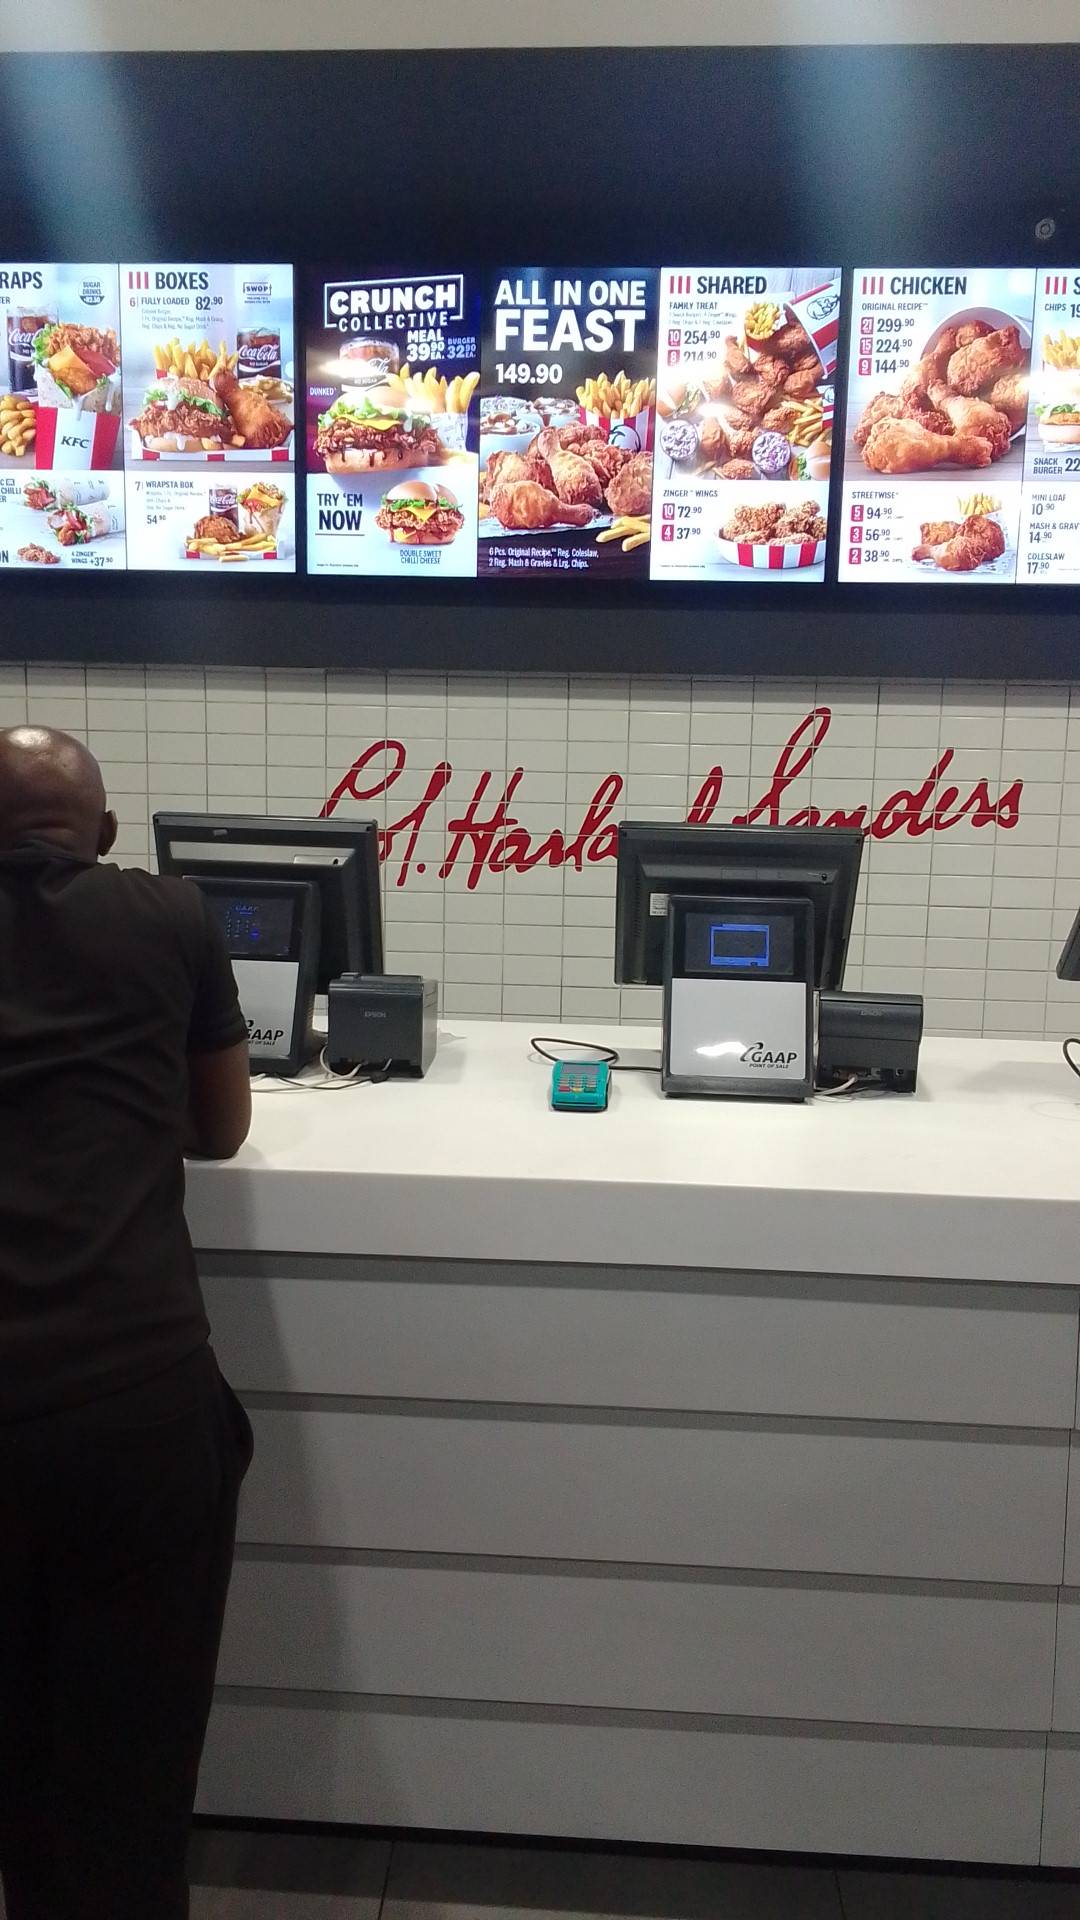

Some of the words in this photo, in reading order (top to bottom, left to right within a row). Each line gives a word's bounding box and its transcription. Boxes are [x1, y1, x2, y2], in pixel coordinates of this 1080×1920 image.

[0, 271, 43, 289] RAPS
[155, 271, 209, 290] BOXES
[697, 275, 768, 294] SHARED
[890, 275, 967, 295] CHICKEN
[245, 285, 269, 293] SWOP
[494, 280, 547, 305] ALL
[554, 280, 581, 306] IN
[588, 280, 647, 306] ONE
[141, 296, 161, 305] FULLY
[163, 296, 190, 305] LOADED
[330, 284, 456, 316] CRUNCH
[669, 302, 694, 310] FAMILY
[696, 302, 718, 310] TREAT
[862, 303, 896, 311] ORIGINAL
[1044, 303, 1067, 311] CHIPS
[338, 311, 448, 332] COLLECTIVE
[876, 318, 915, 332] 299.90
[407, 328, 445, 343] MEAL
[495, 309, 646, 352] FEAST
[448, 336, 476, 345] BURGER
[684, 330, 721, 345] 254.90
[876, 338, 913, 353] 224.90
[875, 359, 910, 373] 144.90
[495, 363, 563, 384] 149.90
[60, 435, 91, 449] KFC
[1033, 457, 1058, 466] SNACK
[1033, 466, 1063, 475] BURGER
[134, 480, 141, 491] 7
[146, 481, 178, 489] WRAPSTA
[316, 493, 340, 507] TRY
[695, 490, 718, 498] WINGS
[1032, 493, 1048, 501] MINI
[1049, 493, 1066, 501] LOAF
[677, 505, 702, 518] 72.90
[854, 506, 861, 517] 5
[866, 507, 893, 519] 94.90
[318, 509, 362, 531] NOW
[1029, 522, 1051, 530] MASH
[664, 526, 672, 538] 4
[676, 527, 702, 540] 37.90
[853, 528, 860, 539] 3
[865, 529, 891, 541] 56.90
[1029, 532, 1053, 543] 14.90
[400, 550, 422, 558] DOUBLE
[423, 550, 442, 558] SWEET
[489, 548, 494, 556] 6
[495, 547, 506, 556] Pcs.
[507, 547, 531, 557] Original
[557, 548, 571, 558] Reg.
[571, 548, 599, 558] Coleslaw,
[852, 549, 859, 561] 2
[864, 550, 890, 562] 38.90
[1027, 553, 1065, 561] COLESLAW
[420, 557, 441, 565] CHEESE
[489, 559, 494, 567] 2
[508, 558, 524, 567] Mash
[530, 559, 552, 567] Gravies
[558, 559, 571, 569] Lrg.
[571, 559, 590, 569] Chips.
[1027, 562, 1050, 574] 17.90
[751, 1051, 797, 1063] GAAP
